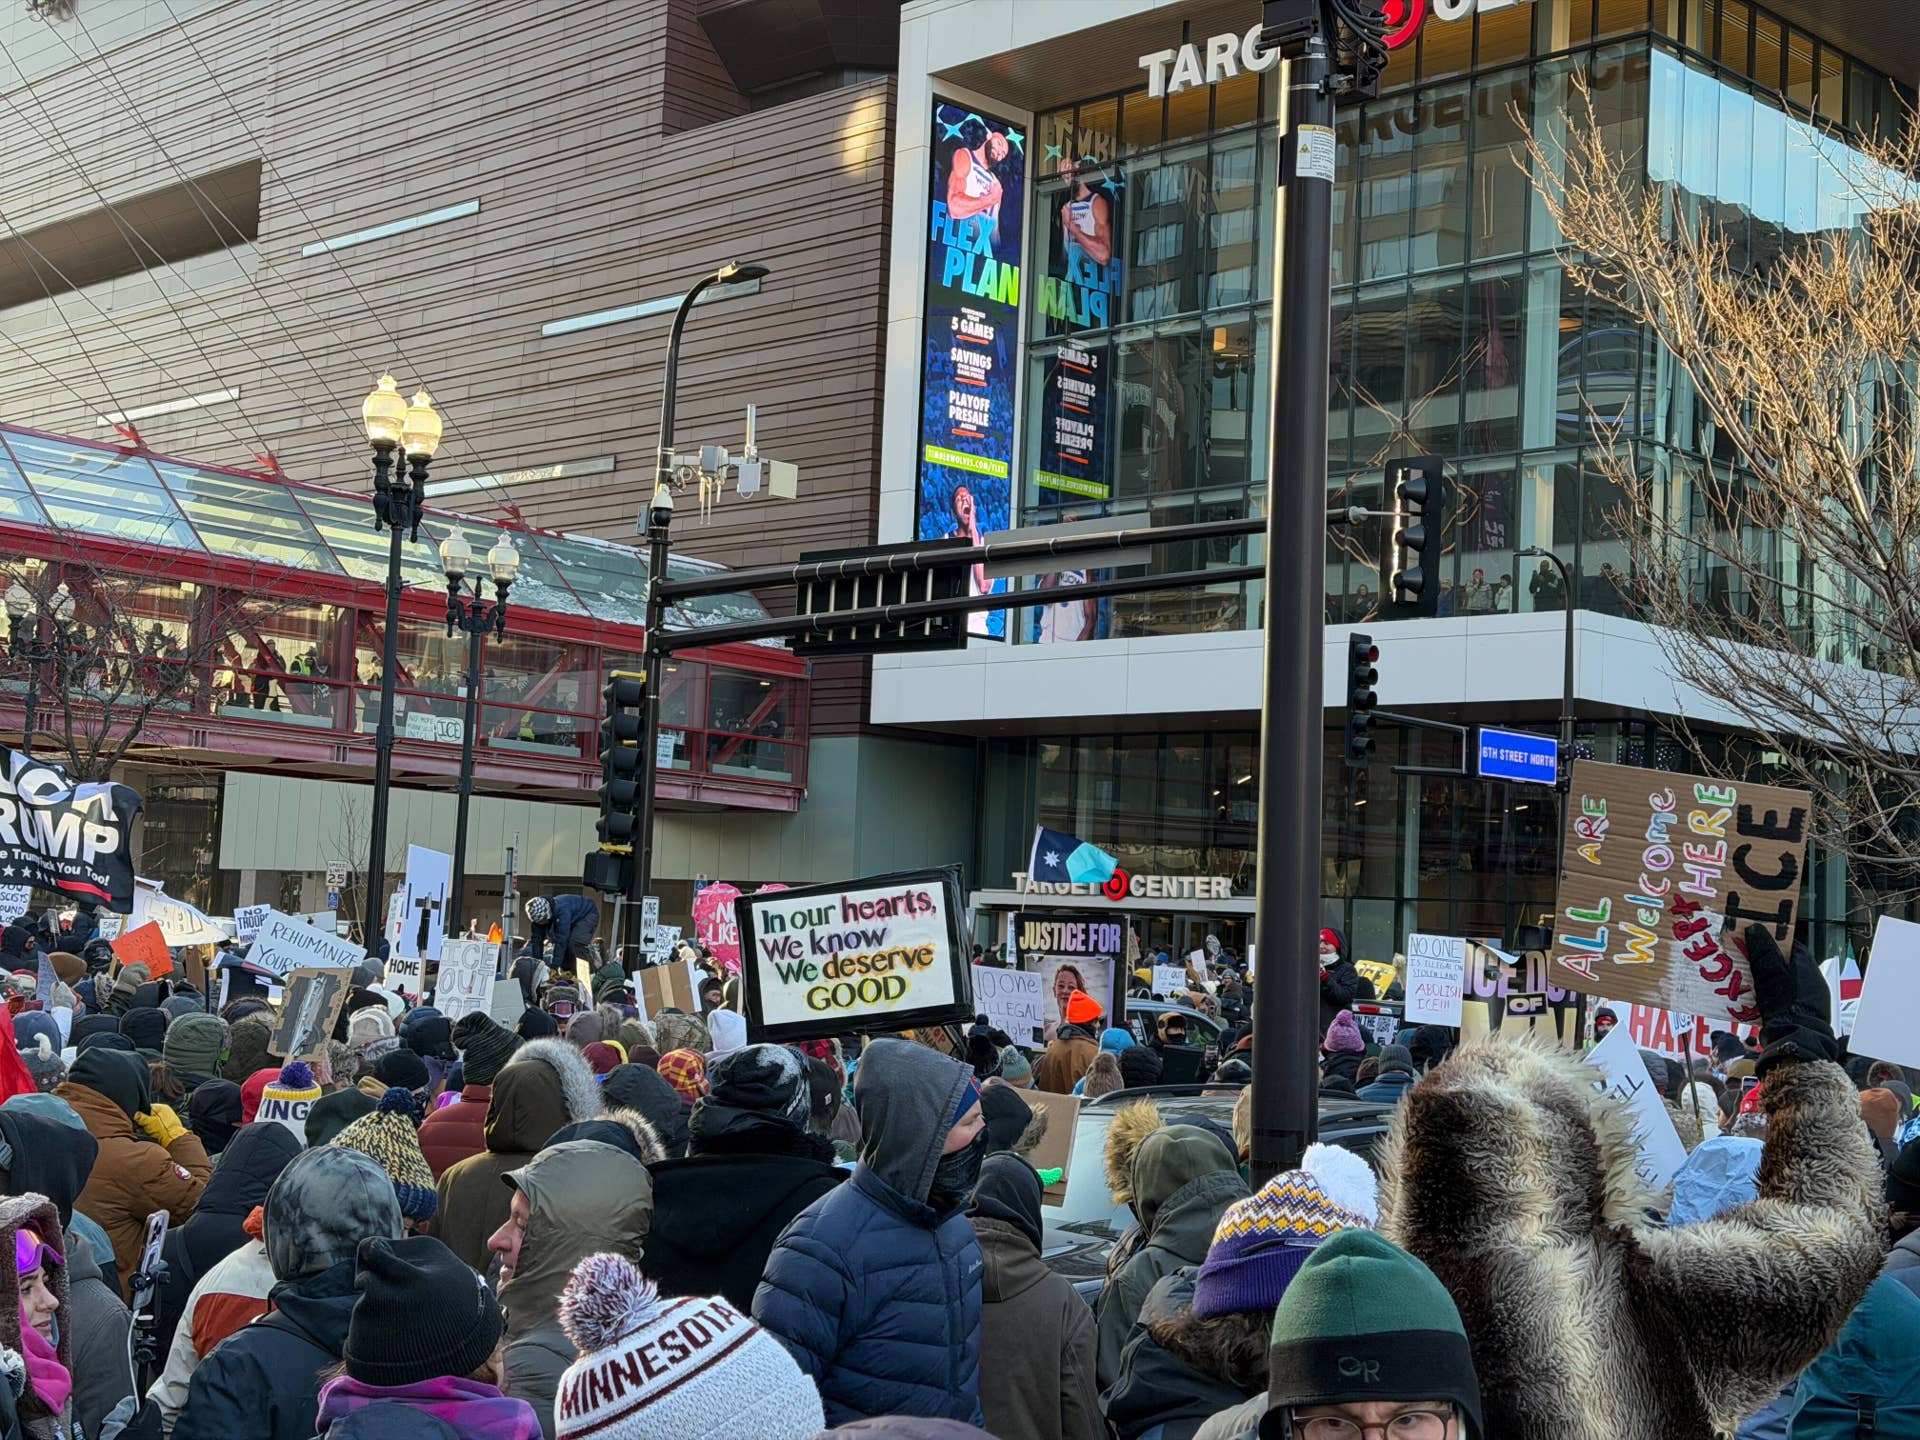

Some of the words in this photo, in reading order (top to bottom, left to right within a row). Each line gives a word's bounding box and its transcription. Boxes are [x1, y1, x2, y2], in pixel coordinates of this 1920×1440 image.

[1138, 22, 1279, 98] TARG
[931, 199, 997, 258] FLEX
[943, 245, 1019, 306] PLAN
[951, 316, 959, 331] 5
[961, 319, 995, 340] GAMES
[950, 347, 992, 370] SAVINGS
[949, 390, 990, 412] PLAYOFF
[948, 405, 989, 427] PRESALE
[1499, 749, 1529, 763] STREET
[1530, 753, 1555, 767] NORTH
[1573, 794, 1611, 866] ARE
[1677, 782, 1738, 899] HERE
[56, 862, 81, 875] You
[85, 866, 110, 886] Too!
[328, 874, 345, 884] 25
[1724, 804, 1807, 941] ICE
[1130, 874, 1233, 899] CENTER
[644, 902, 657, 915] ONE
[761, 909, 787, 934] In
[790, 904, 836, 929] our
[841, 889, 936, 923] hearts,
[271, 922, 359, 968] REHUMANIZE
[760, 935, 804, 962] We
[809, 927, 887, 955] know
[1019, 922, 1086, 952] JUSTICE
[1088, 924, 1121, 953] FOR
[1410, 937, 1429, 956] NO
[1432, 938, 1464, 959] ONE
[1557, 897, 1613, 982] ALL
[389, 958, 419, 976] HOME
[441, 942, 498, 969] ICE
[775, 959, 819, 984] We
[822, 947, 934, 980] deserve
[1411, 959, 1421, 967] IS
[1424, 960, 1452, 970] ILLEGAL
[438, 967, 495, 996] OUT
[807, 975, 907, 1011] GOOD
[999, 973, 1038, 994] One
[980, 1001, 1044, 1021] ILLEGAL
[1509, 997, 1543, 1012] OF
[559, 1302, 743, 1421] MINNESOTA
